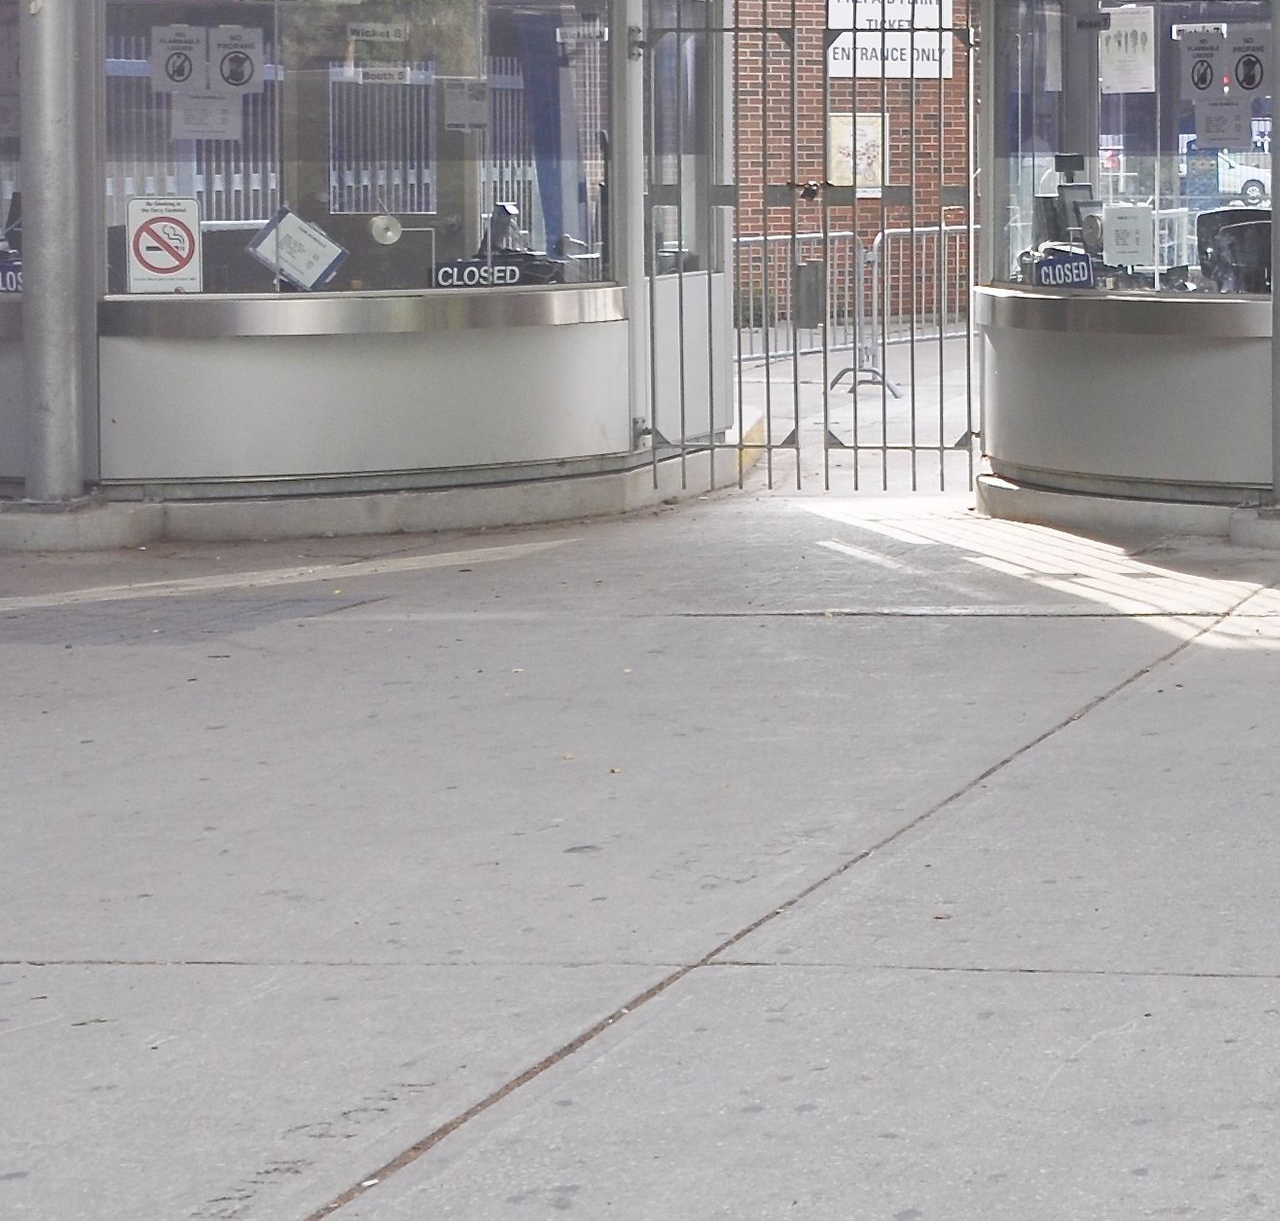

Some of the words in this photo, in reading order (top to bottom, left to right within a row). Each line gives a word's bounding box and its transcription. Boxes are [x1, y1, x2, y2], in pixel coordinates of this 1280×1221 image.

[832, 46, 907, 62] ENTRANCE
[1232, 45, 1265, 53] PROPANE
[362, 70, 395, 81] Booth
[0, 271, 23, 291] LOS
[437, 265, 520, 287] CLOSED
[1041, 261, 1088, 285] CLOSED
